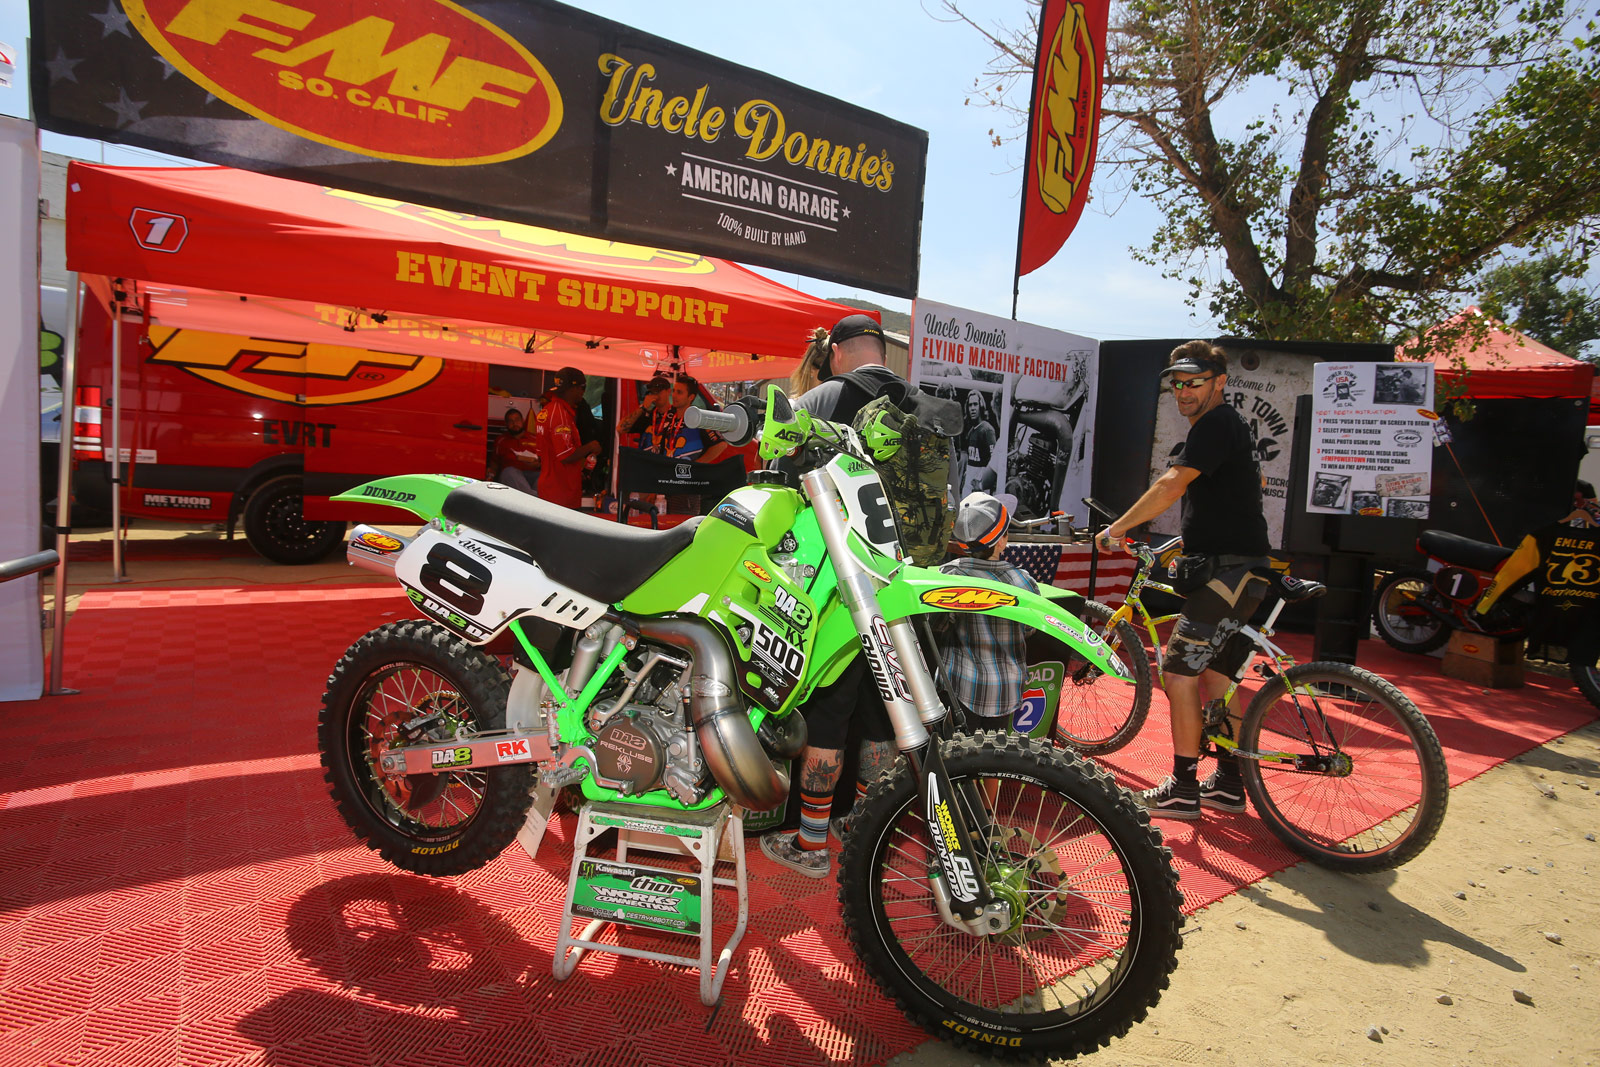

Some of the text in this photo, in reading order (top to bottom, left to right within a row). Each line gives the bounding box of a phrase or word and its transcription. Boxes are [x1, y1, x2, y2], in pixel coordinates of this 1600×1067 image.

[166, 0, 537, 111] FMF
[278, 70, 452, 127] SO. CALIF.
[598, 52, 895, 192] Uncle Donnie's
[681, 161, 839, 222] AMERICAN GARAGE
[145, 217, 173, 245] 1
[716, 212, 807, 246] 100% BUILT BY HAND
[396, 250, 730, 330] EVENT SUPPORT
[924, 312, 1007, 350] Uncle Donnie's
[922, 337, 1068, 382] FLYING MACHINE FACTORY
[1266, 380, 1276, 393] to
[1335, 376, 1349, 384] USA
[1251, 396, 1288, 437] TOWN
[144, 494, 210, 505] METHOD
[361, 485, 416, 502] DUNLOP
[1261, 488, 1287, 499] MUSCL
[1554, 537, 1595, 550] EMLER
[419, 542, 493, 616] 8
[743, 560, 772, 583] FMF
[1547, 551, 1600, 586] 73
[924, 587, 1018, 607] FMF
[1450, 573, 1463, 596] 1
[774, 584, 813, 628] DA8
[755, 622, 804, 678] 500
[784, 626, 807, 653] KX
[859, 632, 894, 702] SHOWA
[1027, 667, 1055, 683] OAD
[1016, 701, 1035, 726] 2
[432, 747, 471, 764] DA8
[497, 740, 527, 757] RK
[600, 740, 653, 763] REKLUSE
[997, 772, 1020, 781] EXCEL
[934, 804, 954, 852] CONNECTION
[940, 799, 962, 851] WORKS
[411, 839, 459, 856] DUNLOP
[928, 821, 964, 898] DUNLOP
[595, 864, 636, 877] Kawasaki
[590, 885, 682, 906] WORKS
[631, 877, 683, 895] thor
[942, 1019, 1022, 1047] DUNLOP
